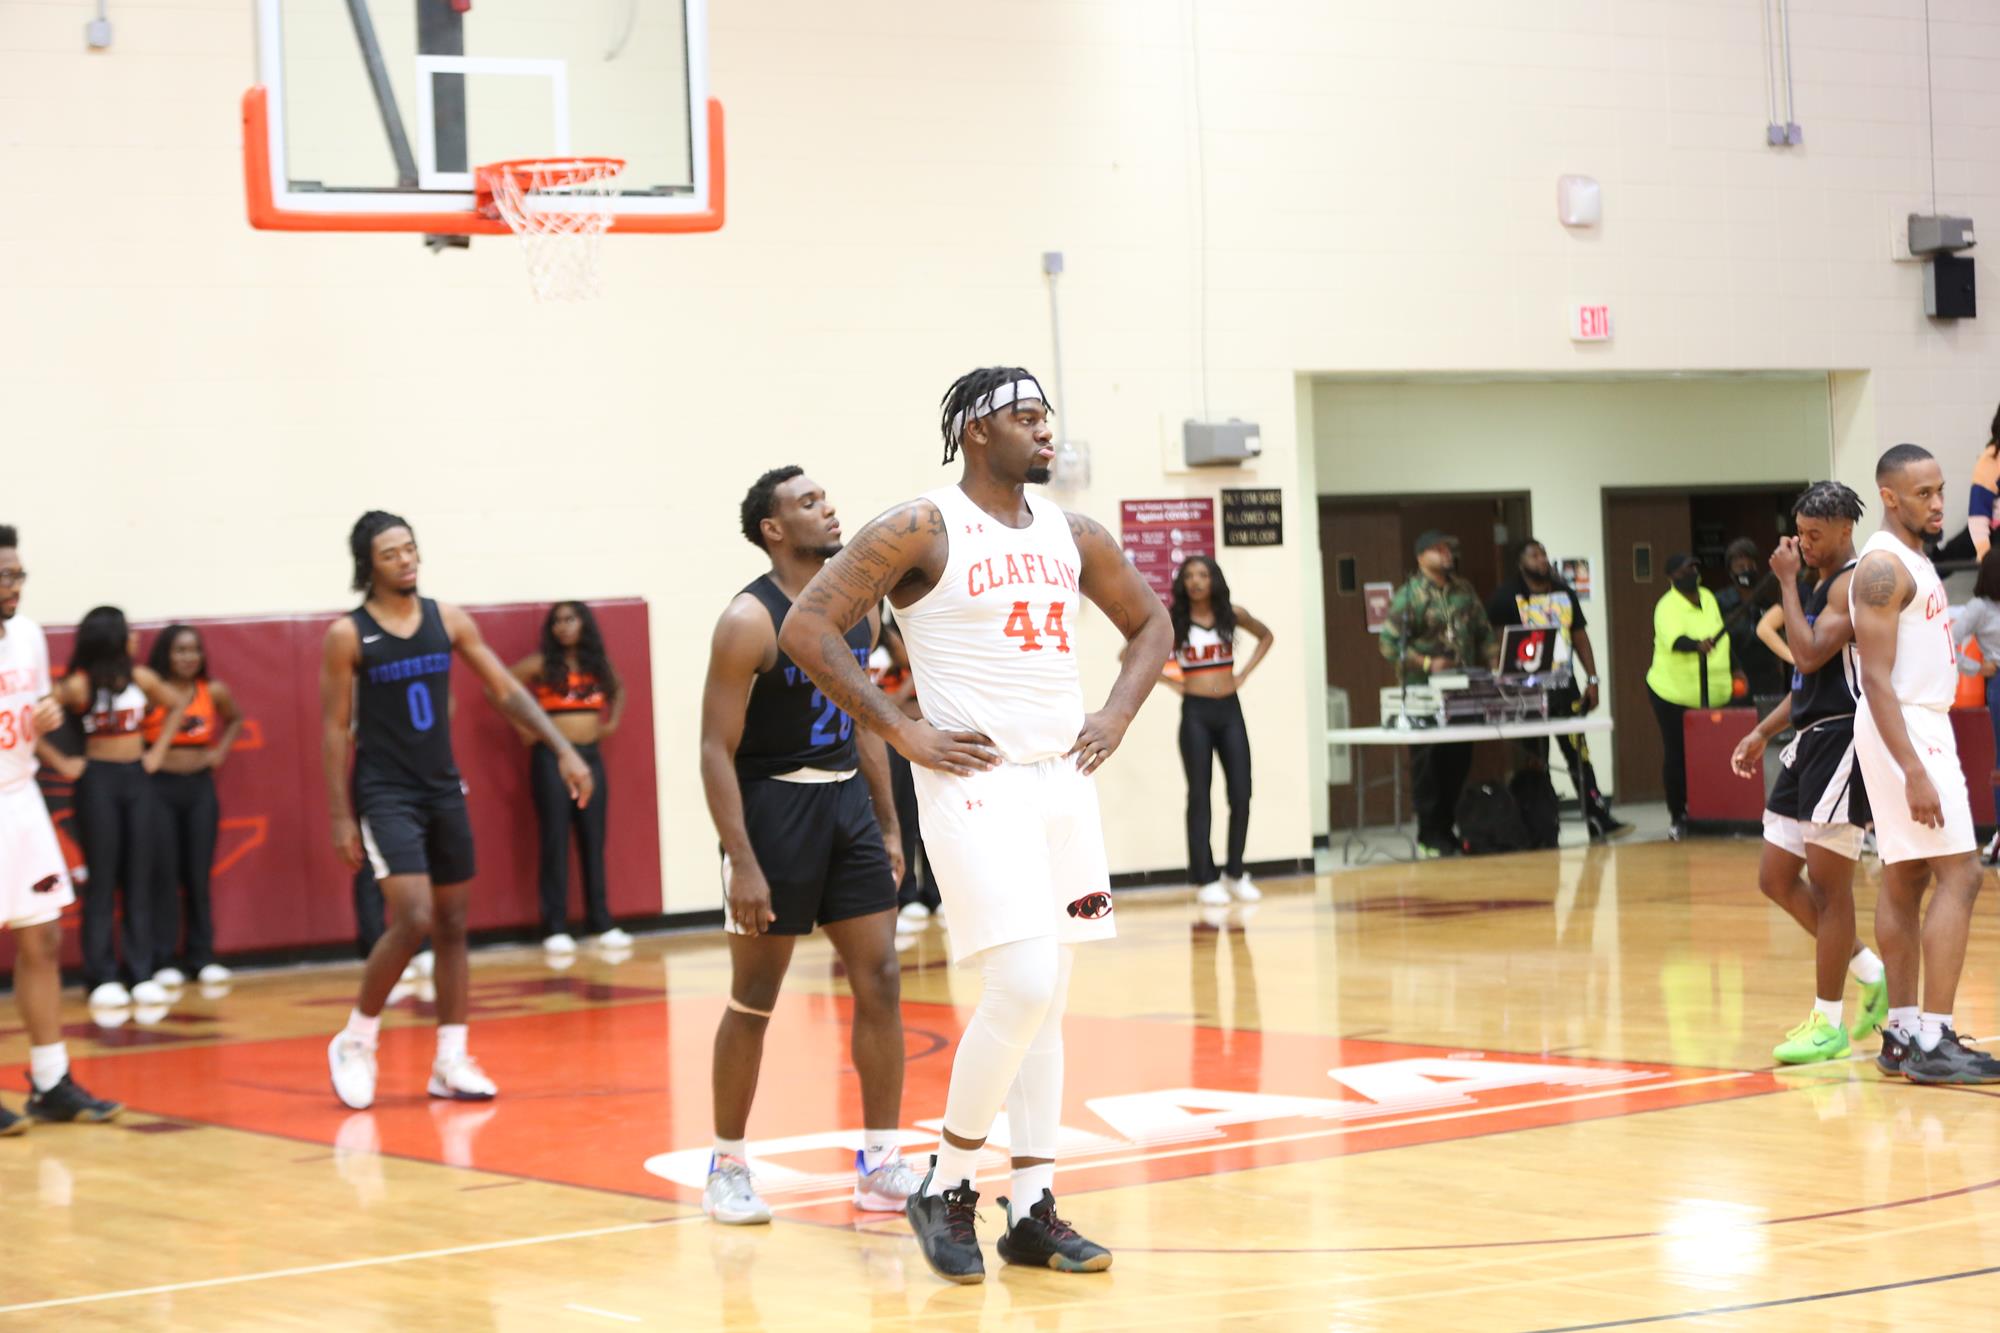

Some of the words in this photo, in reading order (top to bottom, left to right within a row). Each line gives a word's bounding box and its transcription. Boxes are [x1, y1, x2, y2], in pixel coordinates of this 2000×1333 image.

[1580, 306, 1608, 336] EXIT
[1225, 511, 1265, 525] ALLOWED
[1003, 601, 1071, 653] 44
[407, 682, 434, 731] 0
